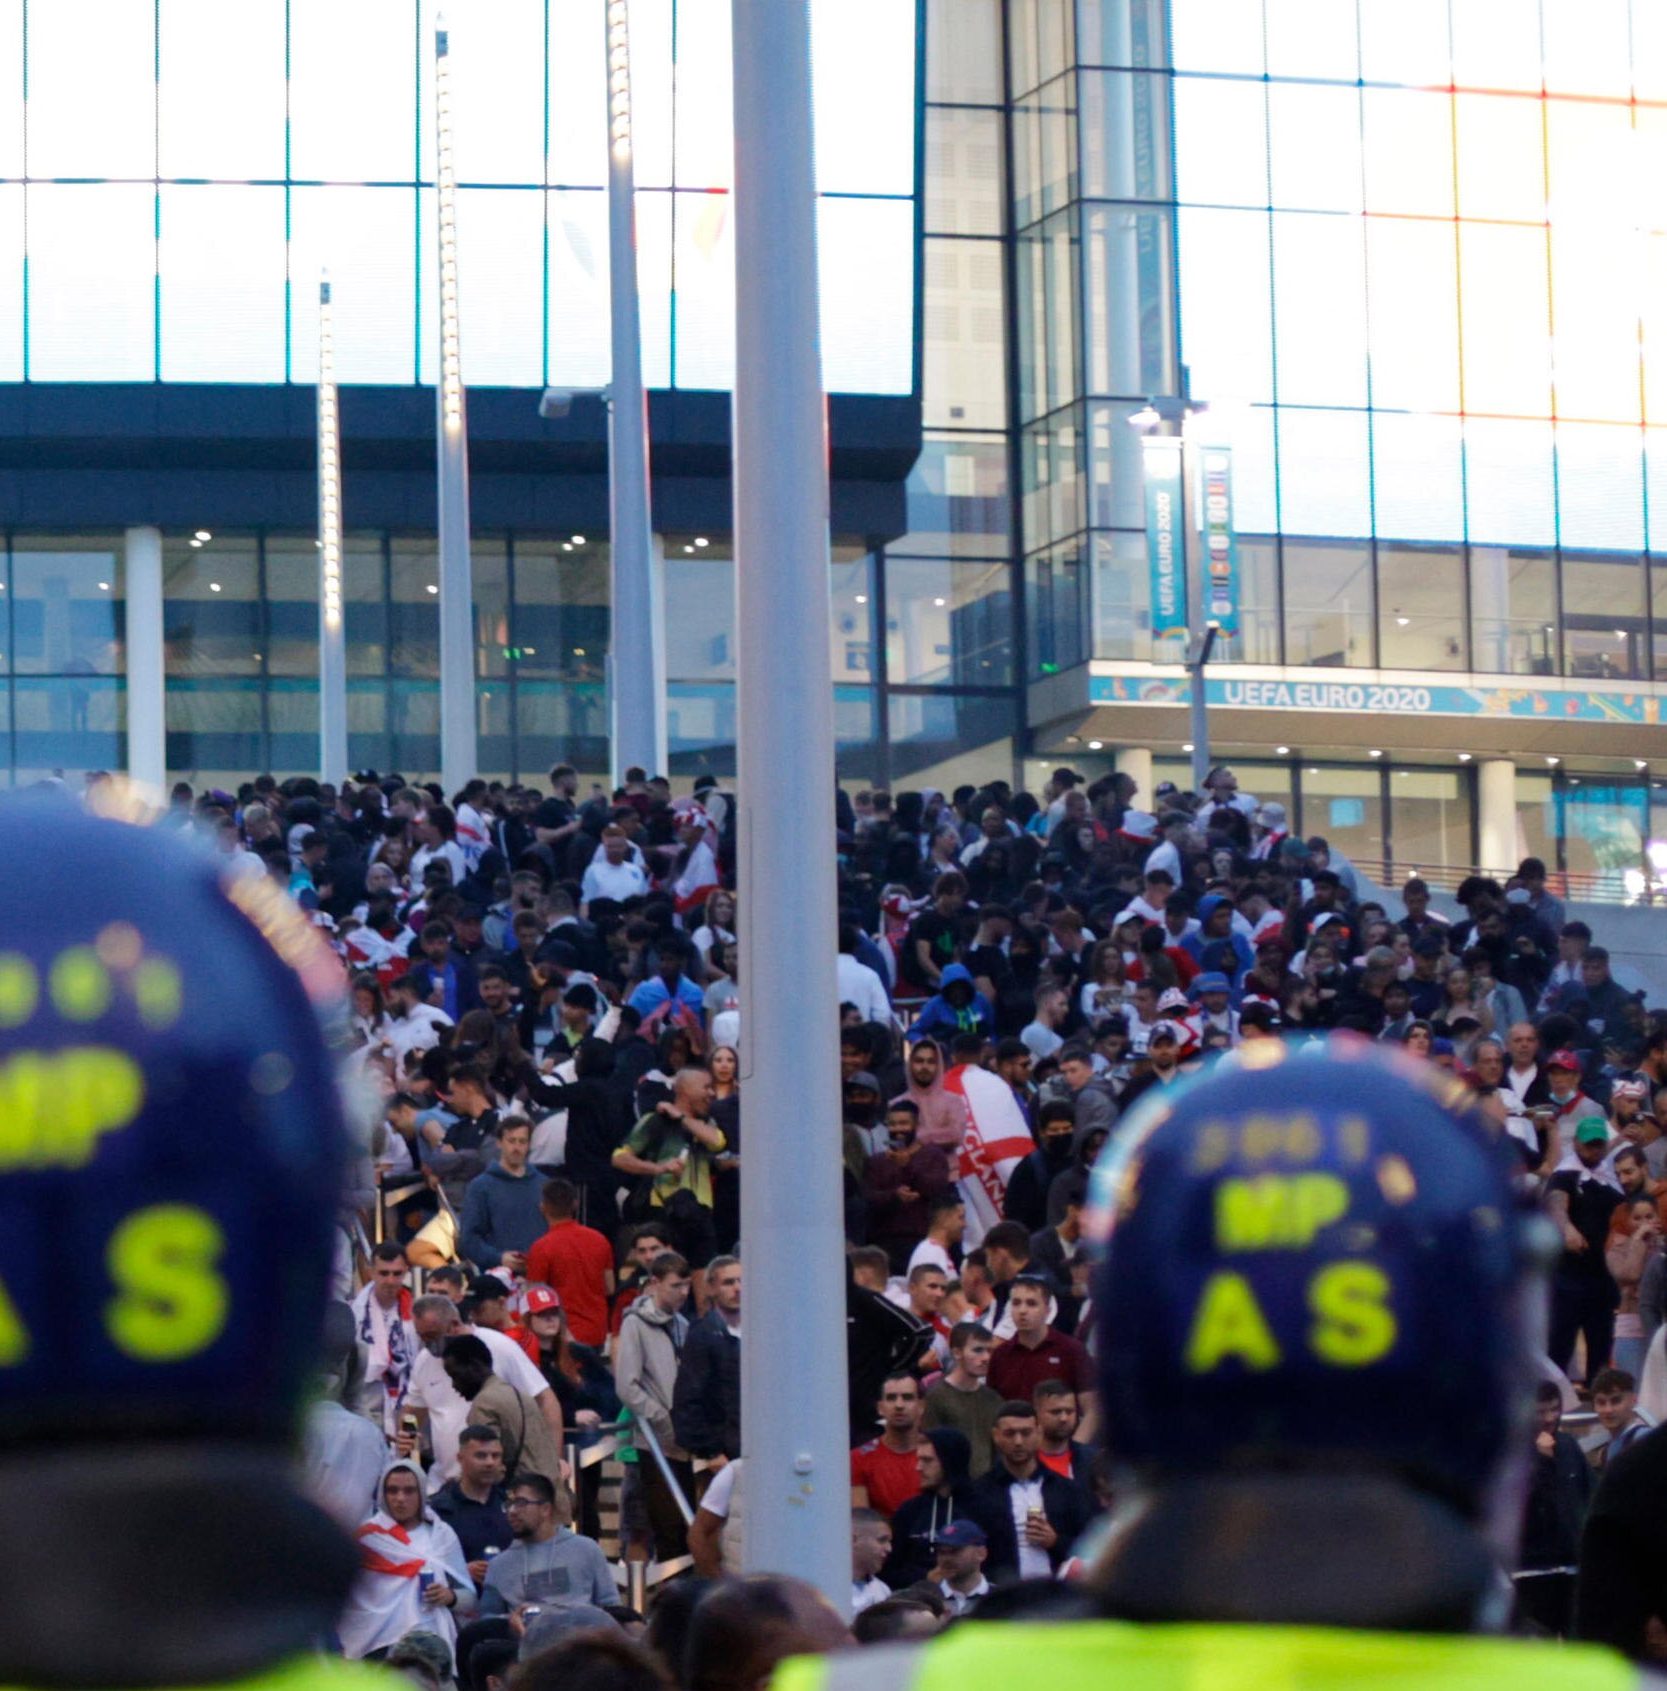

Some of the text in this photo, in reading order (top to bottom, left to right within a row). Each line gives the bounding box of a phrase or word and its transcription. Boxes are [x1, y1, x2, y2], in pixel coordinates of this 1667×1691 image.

[1156, 491, 1174, 616] UEFA EURO 2020
[1224, 681, 1431, 711] UEFA EURO 2020
[1216, 1173, 1350, 1249] MP
